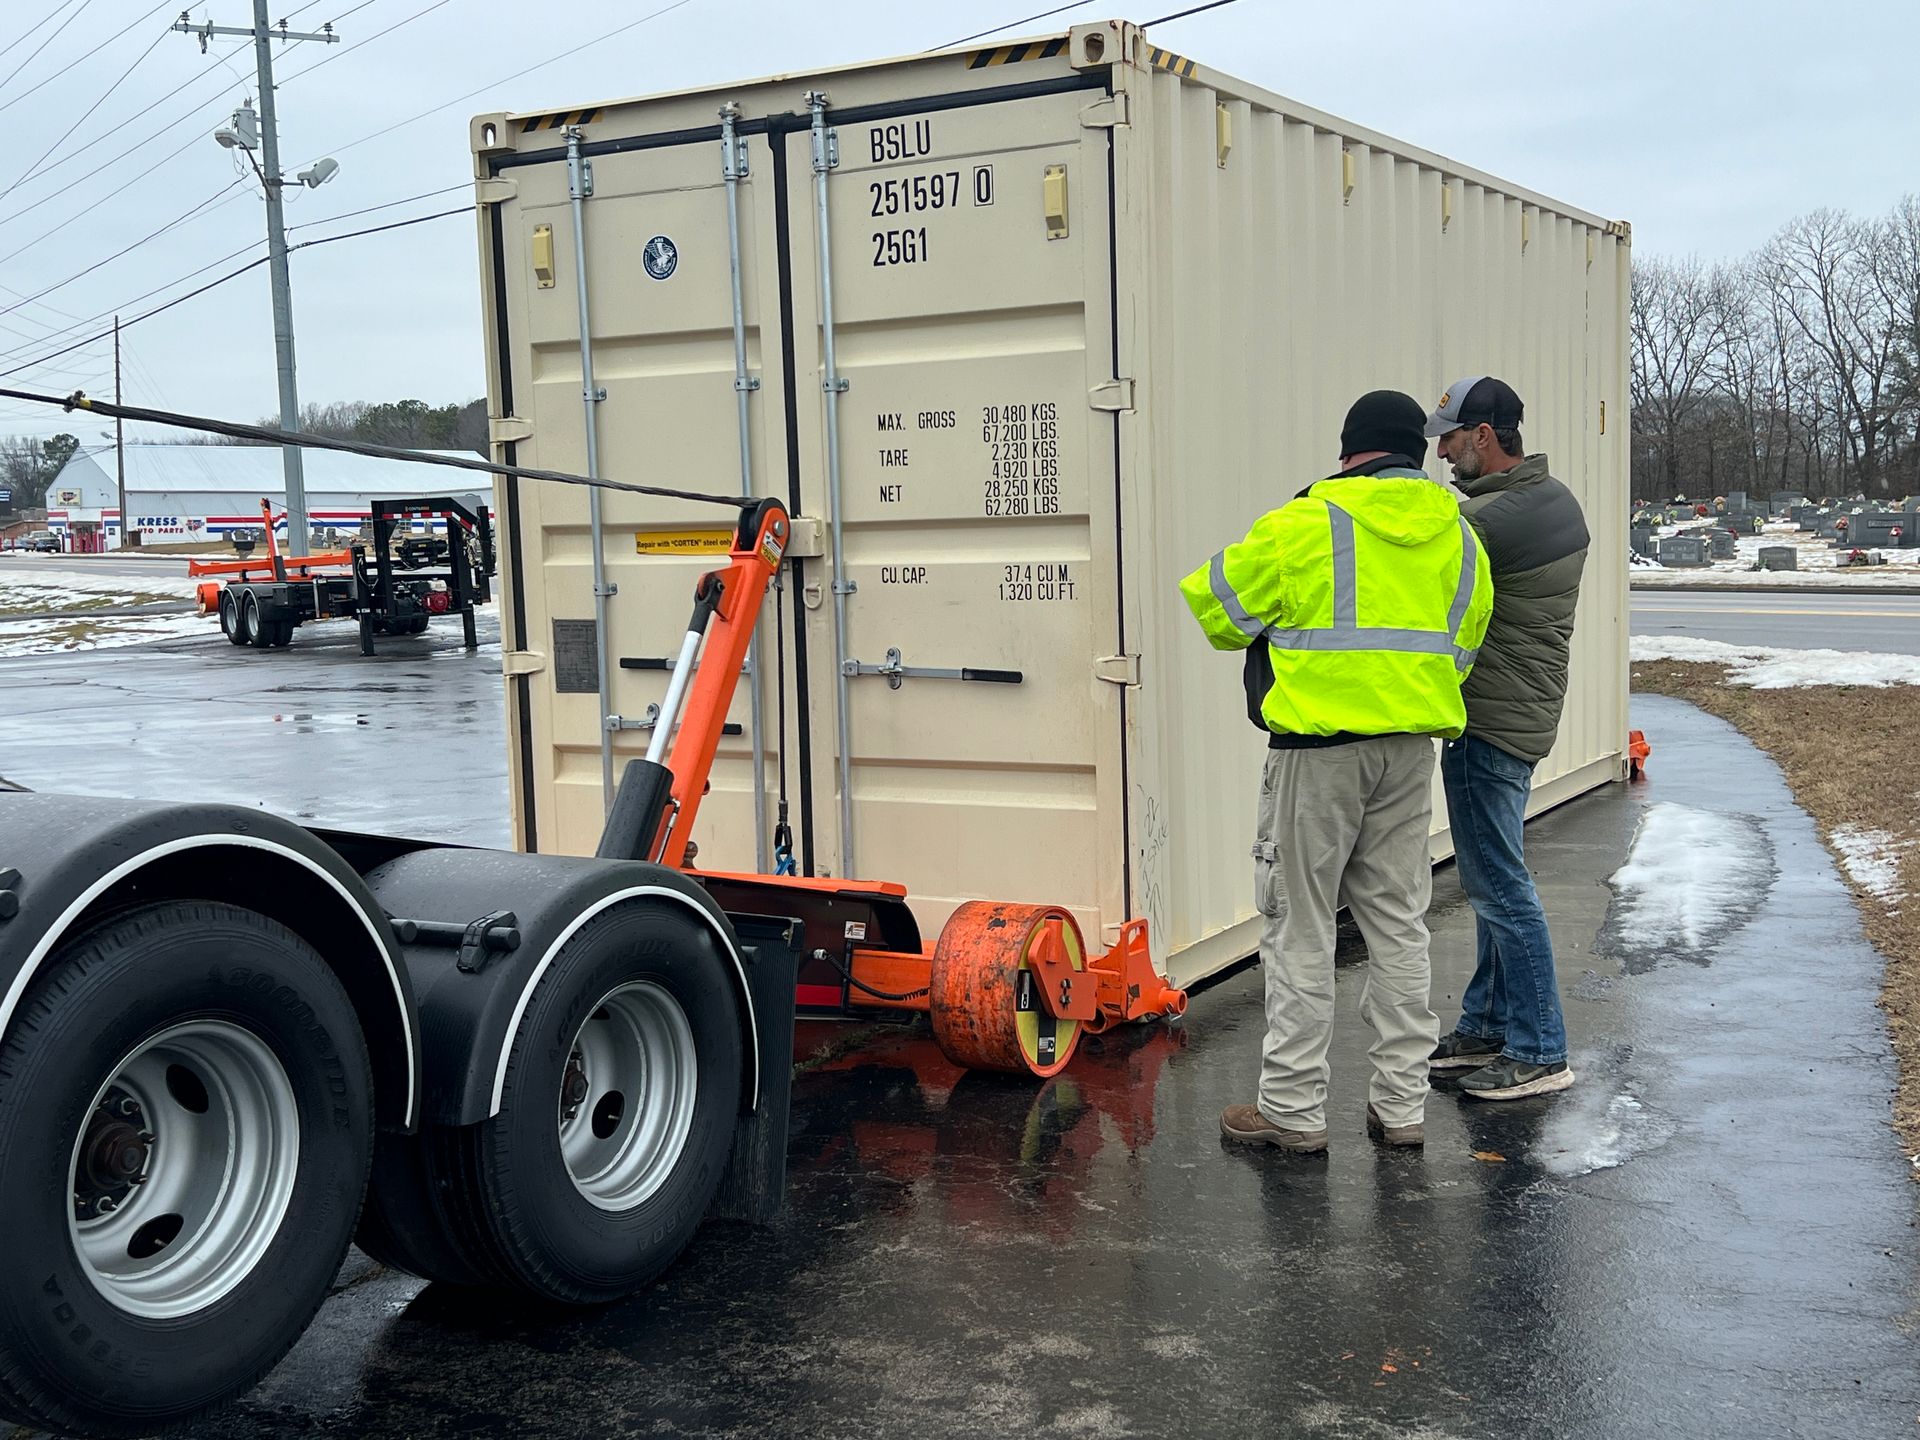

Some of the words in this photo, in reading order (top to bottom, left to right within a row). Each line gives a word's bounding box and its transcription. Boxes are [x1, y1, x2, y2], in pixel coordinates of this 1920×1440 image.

[870, 120, 931, 163] BSLU
[870, 171, 960, 217] 251597
[976, 168, 991, 204] 0
[872, 227, 928, 267] 25G1
[877, 413, 906, 431] MAX.
[918, 411, 956, 429] GROSS
[1031, 403, 1059, 421] KGS.
[1032, 421, 1060, 440] LBS.
[879, 449, 909, 467] TARE
[1032, 440, 1060, 459] KGS.
[1033, 459, 1061, 477] LBS.
[879, 485, 902, 503] NET
[1033, 477, 1061, 496] KGS.
[1034, 496, 1062, 514] LBS.
[137, 517, 177, 526] KRESS
[637, 541, 656, 549] Repair
[1004, 565, 1032, 583] 37.4
[1037, 564, 1072, 583] CU.M.
[1037, 582, 1079, 601] CU.FT.
